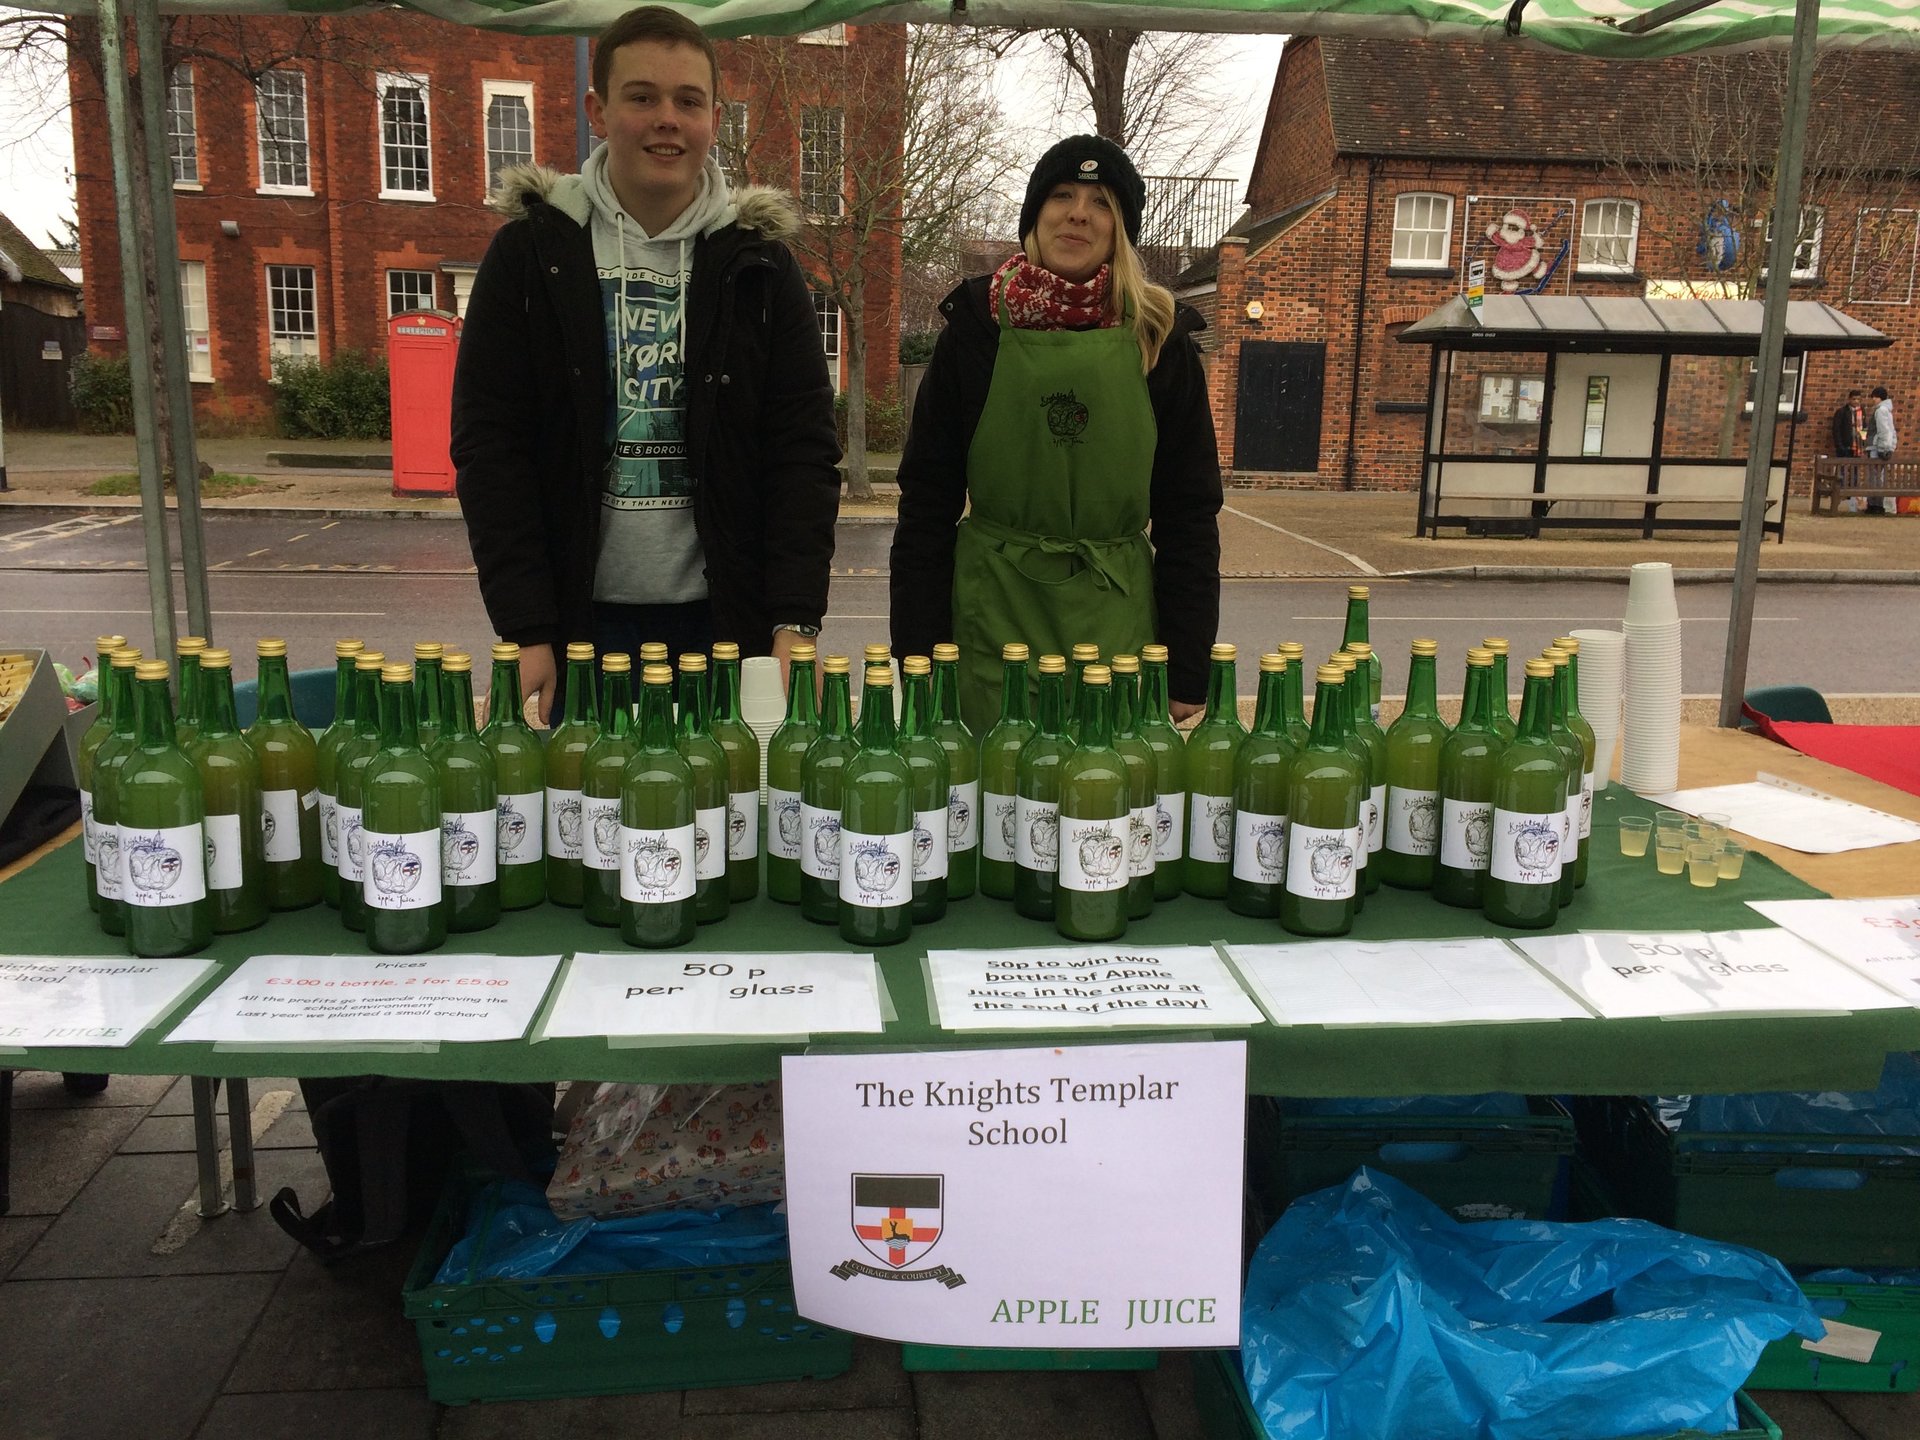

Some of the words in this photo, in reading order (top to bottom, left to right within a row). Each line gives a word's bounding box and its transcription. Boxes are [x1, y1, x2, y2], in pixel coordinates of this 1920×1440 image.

[622, 306, 682, 334] NEW
[400, 327, 445, 336] TELEPHONE
[624, 377, 684, 402] CITY
[1628, 943, 1682, 956] 50
[1692, 948, 1714, 959] p
[66, 964, 159, 976] Templar
[987, 961, 1030, 970] 50p
[1036, 960, 1061, 968] to
[1067, 957, 1109, 968] win
[1114, 955, 1160, 964] two
[1611, 964, 1665, 979] per
[1708, 961, 1790, 977] glass
[682, 963, 734, 977] 50
[748, 968, 766, 980] p
[985, 972, 1068, 982] bottles
[1074, 972, 1097, 982] of
[1105, 969, 1173, 980] Apple
[265, 978, 321, 986] £3.00
[422, 977, 450, 985] for
[456, 978, 509, 986] £5.00
[625, 986, 684, 999] per
[729, 983, 814, 999] glass
[1033, 988, 1056, 997] in
[1063, 988, 1103, 997] the
[1110, 983, 1170, 993] draw
[1179, 983, 1202, 992] at
[418, 995, 482, 1004] improving
[973, 1001, 1014, 1009] the
[1022, 1003, 1067, 1011] end
[1076, 1003, 1100, 1013] of
[1106, 998, 1147, 1008] the
[1155, 997, 1209, 1009] day!
[327, 1010, 382, 1019] planted
[856, 1082, 914, 1108] The
[924, 1079, 1041, 1113] Knights
[1050, 1074, 1179, 1109] Templar
[967, 1118, 1068, 1146] School
[851, 1263, 888, 1279] COURAGE
[901, 1267, 944, 1280] COURTESY
[990, 1298, 1100, 1324] APPLE
[1125, 1298, 1217, 1330] JUICE
